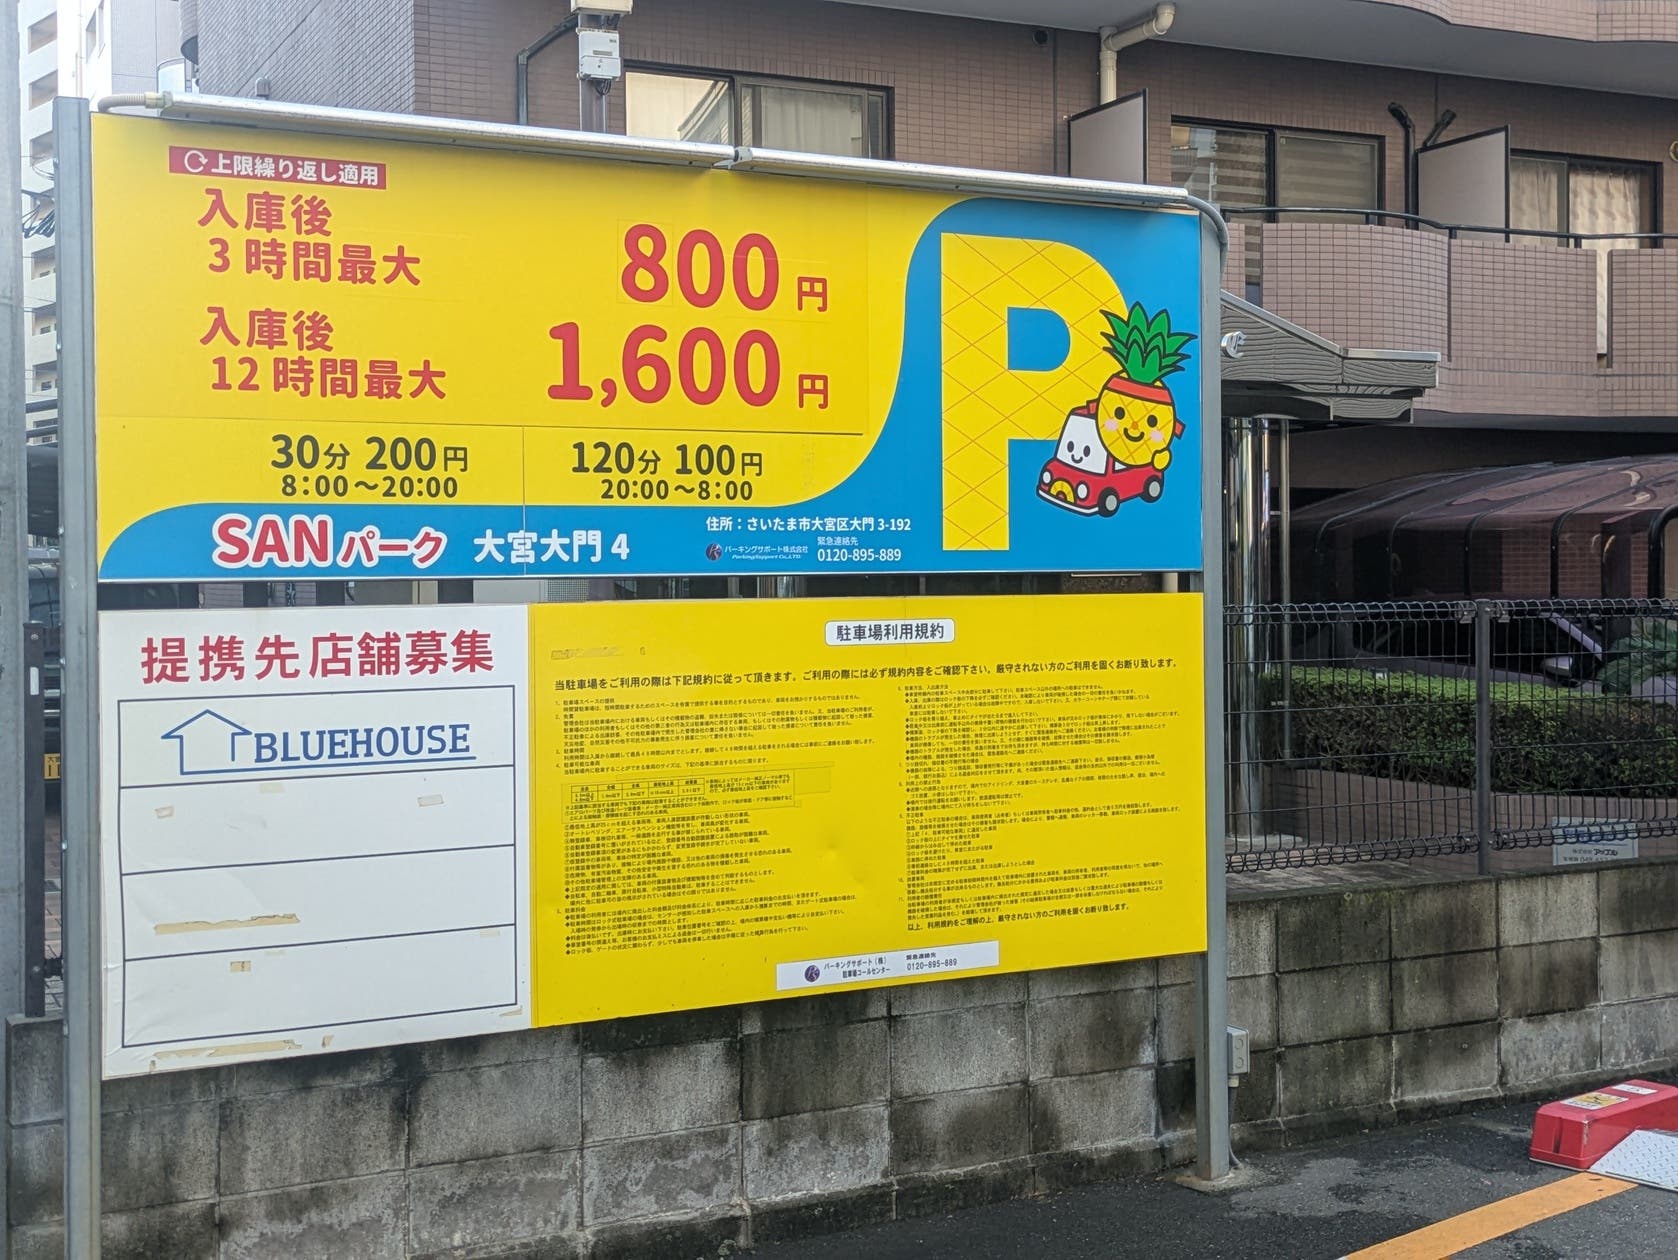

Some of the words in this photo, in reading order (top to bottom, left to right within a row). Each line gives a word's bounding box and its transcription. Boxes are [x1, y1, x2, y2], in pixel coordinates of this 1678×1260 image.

[210, 152, 380, 188] 上限繰り返し適用
[199, 189, 332, 237] 入庫後
[209, 238, 421, 286] 3時間最大
[621, 223, 829, 313] 800円
[201, 306, 334, 352] 入庫後
[213, 356, 446, 399] 12時間最大
[547, 321, 830, 410] 1,600円
[816, 536, 859, 546] 緊急連絡先
[817, 548, 902, 562] 0120-895-889
[836, 622, 945, 643] 駐車場利用規約
[141, 629, 494, 684] 提携先店舗募集
[254, 723, 471, 763] BLUEHOUSE
[906, 958, 958, 971] 0120-895-889
